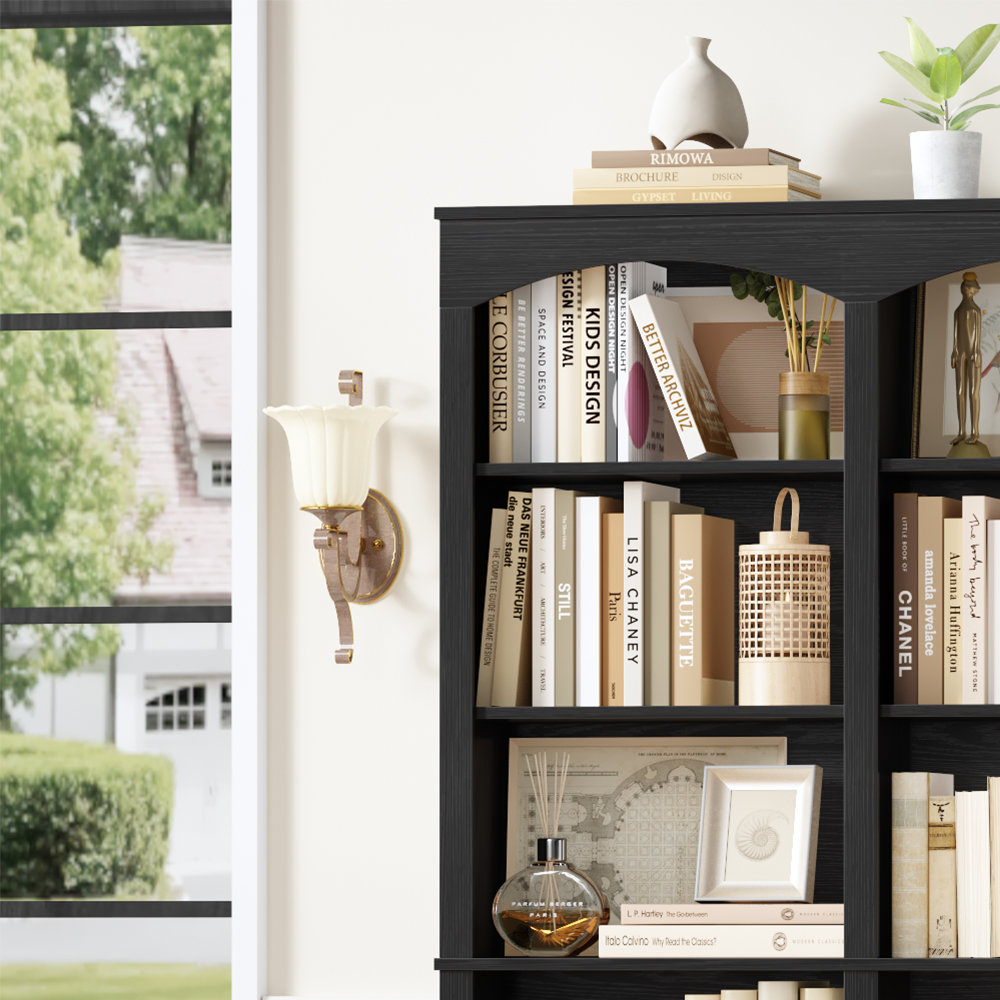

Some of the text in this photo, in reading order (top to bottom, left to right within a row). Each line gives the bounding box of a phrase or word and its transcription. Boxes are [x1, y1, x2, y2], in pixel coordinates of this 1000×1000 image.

[615, 171, 743, 183] BROCHURE DISIGN
[632, 191, 732, 202] GYPSET LIVING
[650, 152, 714, 166] RIMOWA
[516, 299, 527, 423] BE BETTER RENDERINGS
[538, 308, 547, 409] SPACE AND DESIGN
[562, 314, 574, 368] FESTIVAL
[585, 308, 601, 425] KIDS DESIGN
[608, 265, 616, 374] OPEN DESIGN NIGHT
[619, 265, 627, 373] OPEN DESIGN NIGHT
[491, 322, 508, 432] CORBUSIER
[642, 322, 693, 432] BETTER ARCHVIZ
[503, 496, 516, 568] die neue stadt
[513, 497, 532, 621] DAS NEUE FRANKFURT
[902, 563, 908, 572] OF
[558, 582, 571, 621] STILL
[608, 592, 622, 622] Paris
[627, 537, 639, 665] LISA CHANEY
[679, 559, 694, 668] BAGUETTE
[899, 590, 912, 678] CHANEL
[925, 550, 937, 657] amanda lovelace
[946, 551, 961, 674] Arianna Huffington
[605, 935, 621, 946] Italo
[623, 935, 649, 946] Calvino
[652, 937, 665, 948] Why
[666, 937, 680, 946] Read
[681, 936, 690, 946] the
